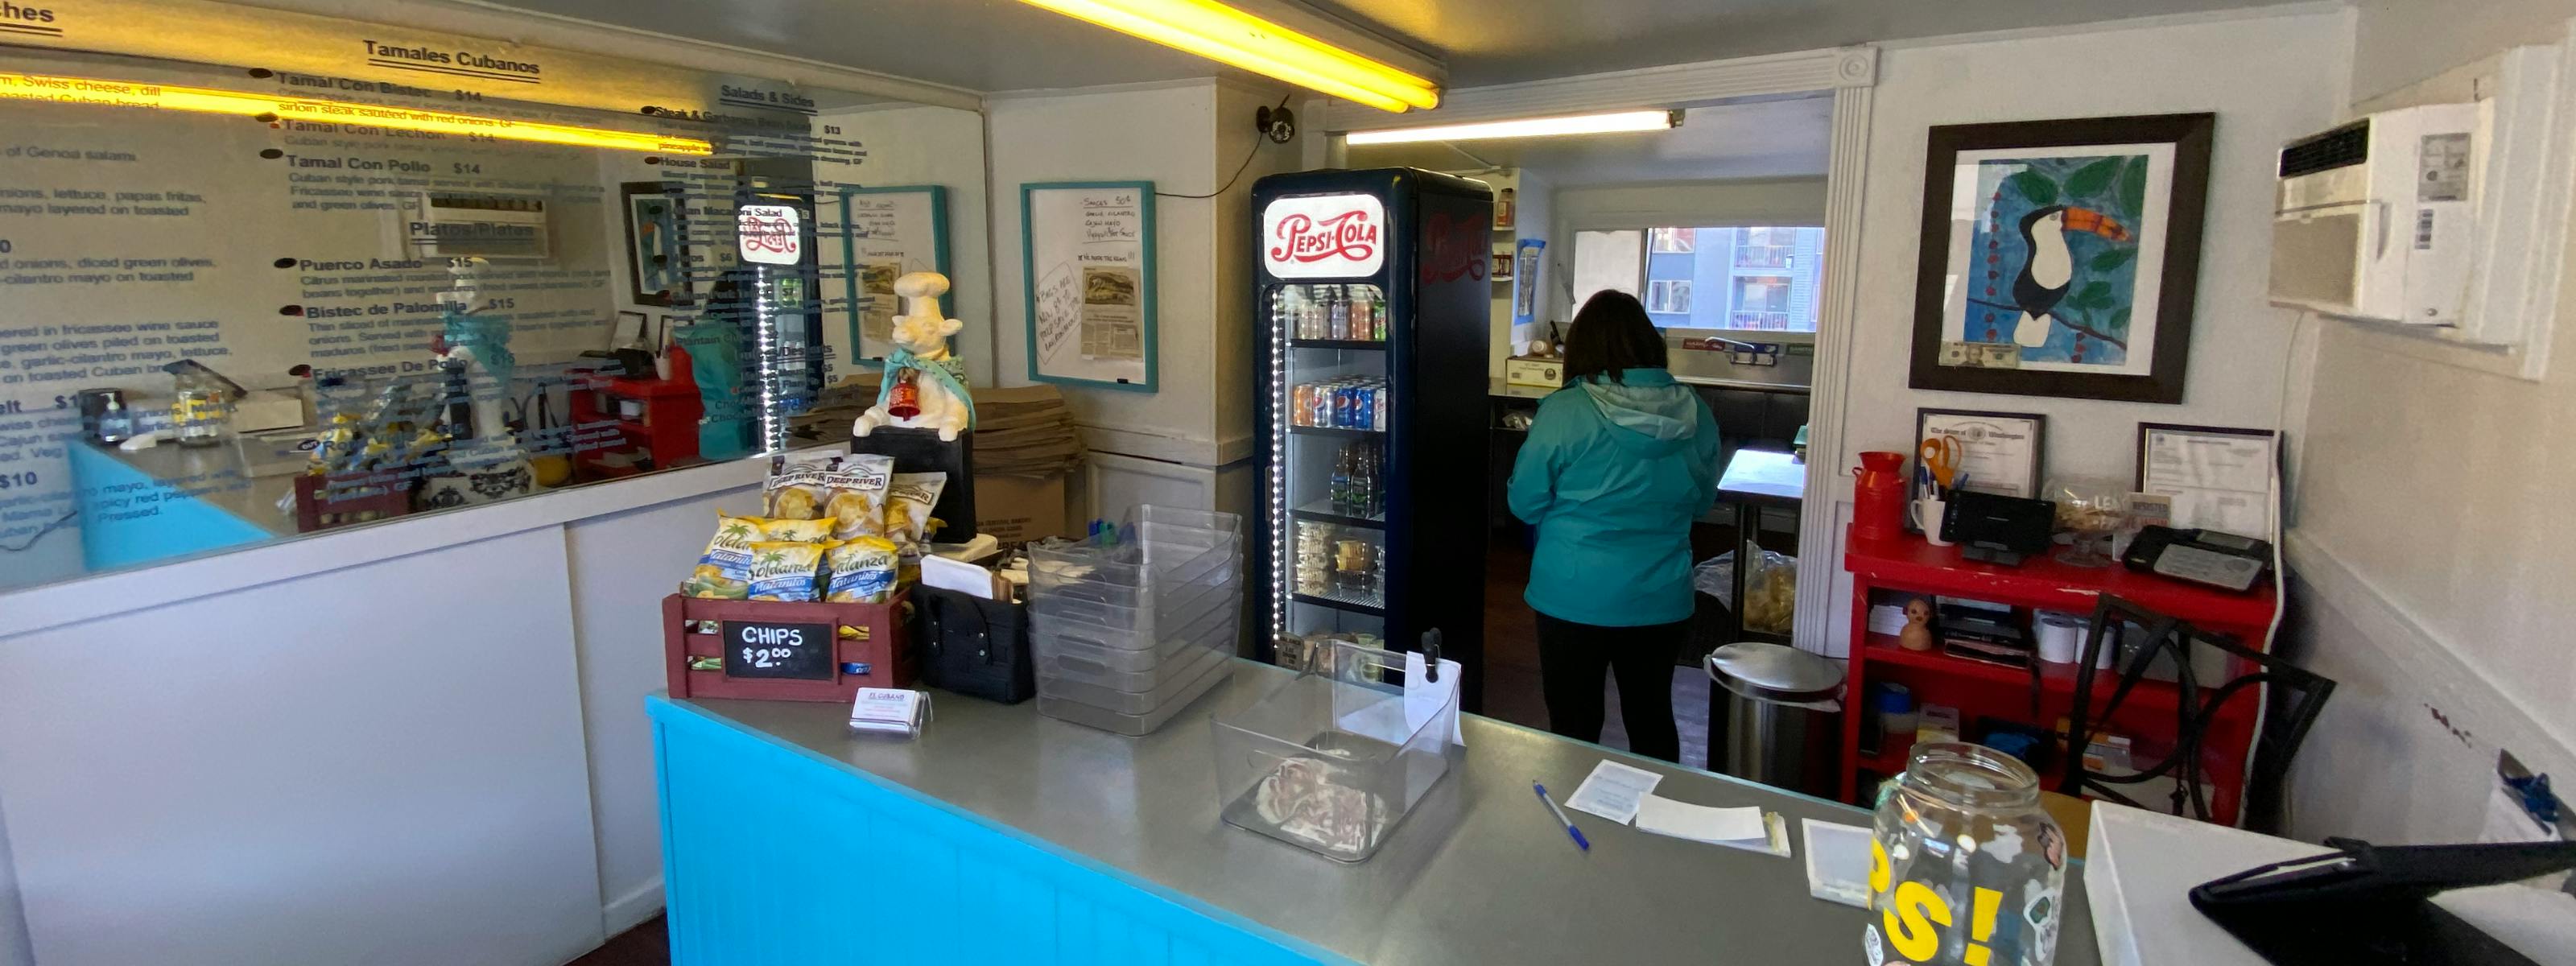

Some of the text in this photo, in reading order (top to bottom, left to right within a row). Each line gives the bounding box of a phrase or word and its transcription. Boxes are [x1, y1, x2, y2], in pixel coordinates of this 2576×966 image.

[363, 39, 540, 74] Tamales Cubanos
[23, 76, 70, 89] Swiss
[141, 85, 161, 97] dill
[276, 72, 482, 101] Tamal Con Bistec $14
[721, 85, 815, 108] Salads & Sides
[411, 113, 433, 122] with
[436, 114, 454, 124] red
[283, 118, 497, 142] Tamal Con Lechon $14
[824, 125, 840, 134] $13
[286, 155, 481, 174] Tamal Con Pollo $14
[659, 157, 730, 169] House Salad
[755, 208, 782, 217] Salad
[409, 221, 535, 237] Platos/Plates
[299, 257, 473, 271] Puerco Asado $15
[307, 298, 514, 319] Bistec de Palomilla $15
[91, 365, 142, 378] Cuban
[312, 364, 397, 381] Fricassee
[402, 360, 423, 373] De
[428, 357, 468, 371] Pollo
[827, 476, 882, 486] DEEP RIVER
[741, 626, 803, 646] CHIPS
